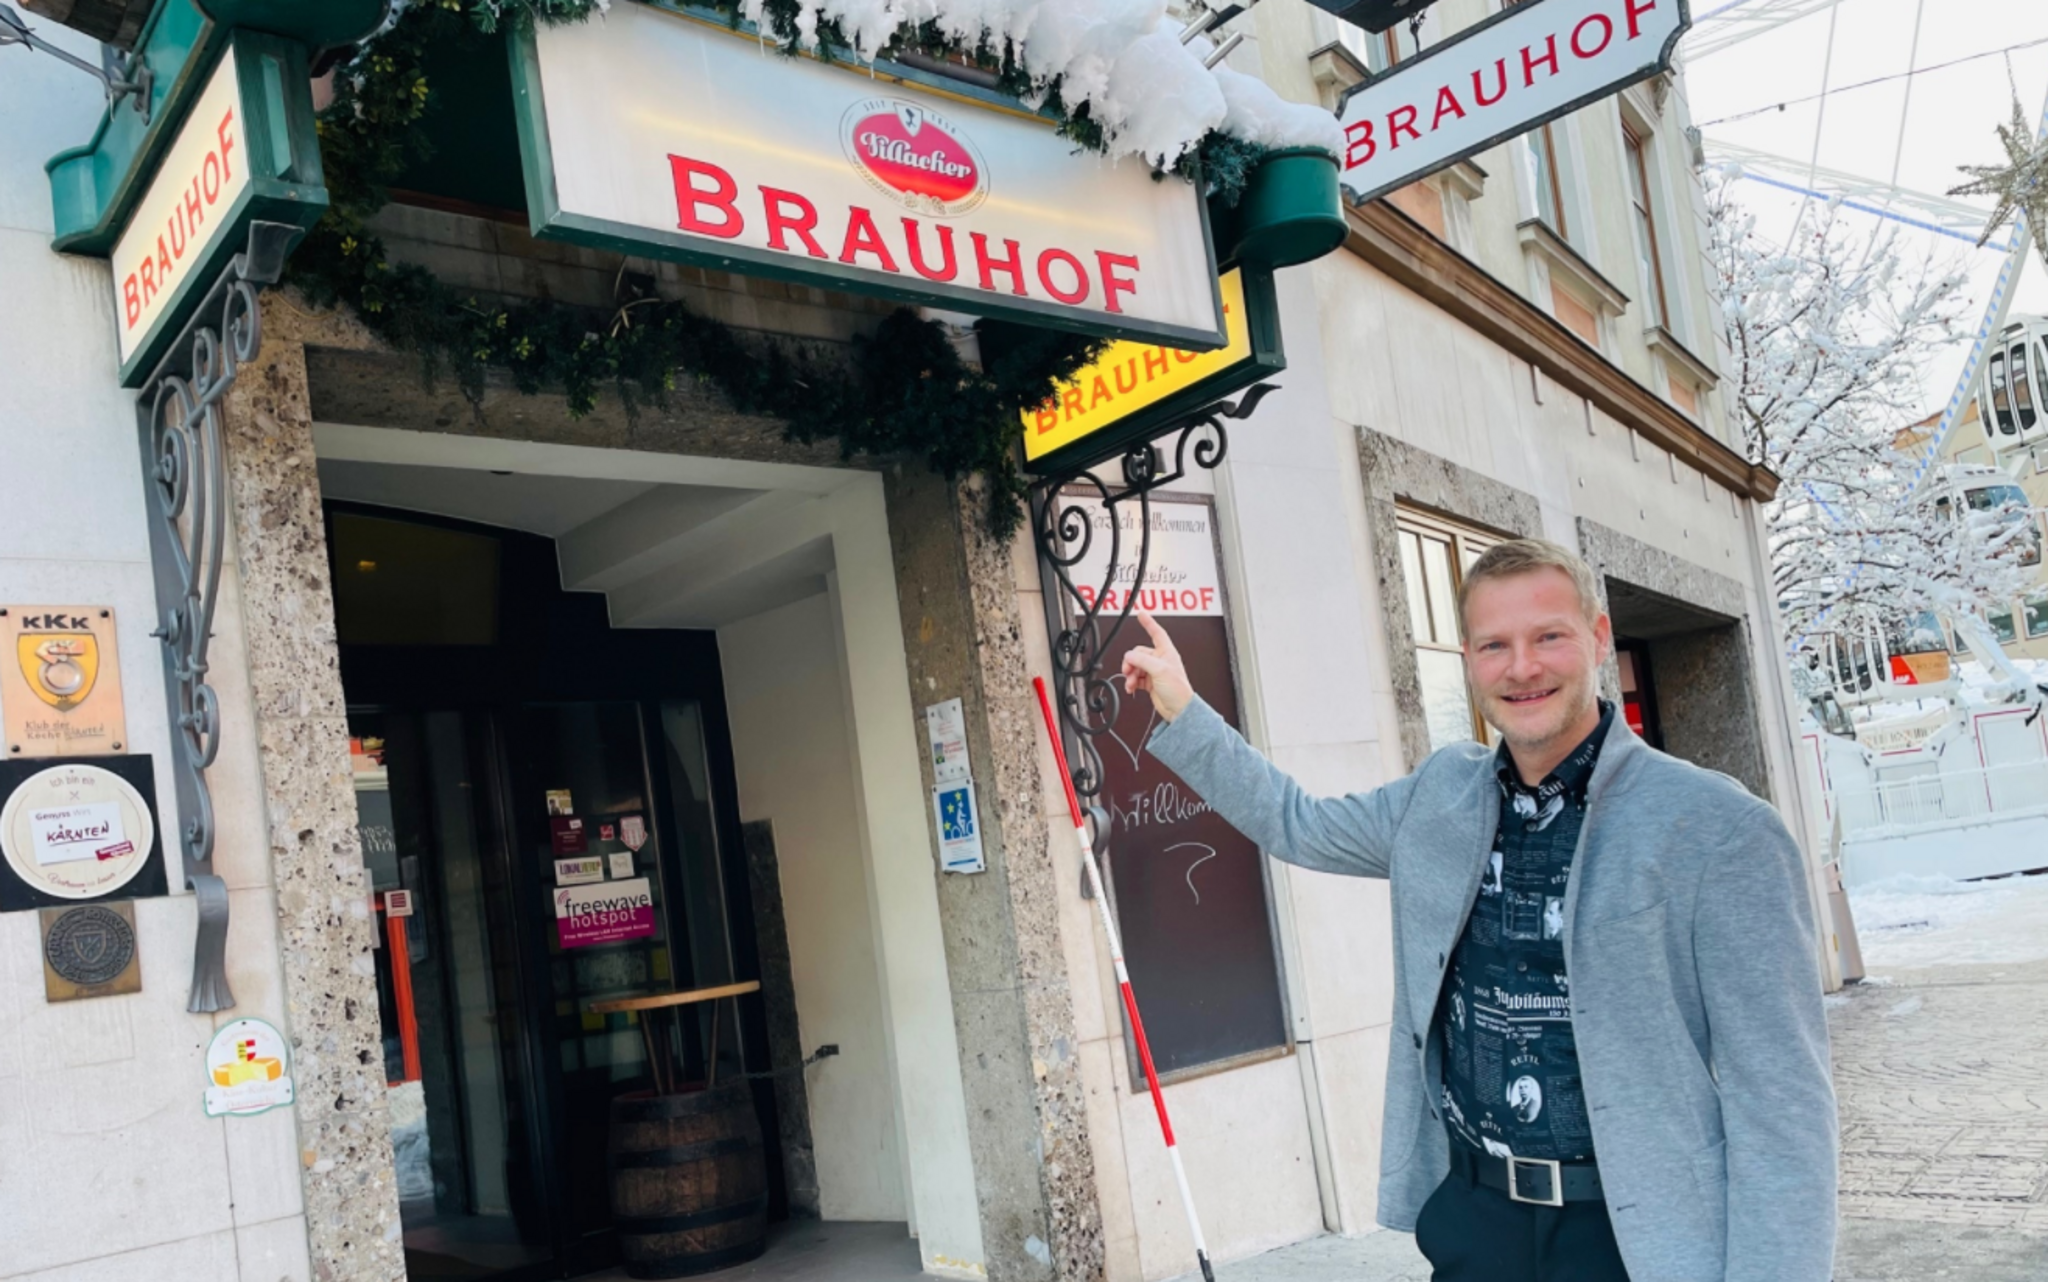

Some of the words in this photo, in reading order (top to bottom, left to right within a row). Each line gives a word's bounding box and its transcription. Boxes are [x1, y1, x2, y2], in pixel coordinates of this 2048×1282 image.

[1343, 0, 1656, 171] BRAUHOF
[859, 131, 972, 179] Villacher
[122, 104, 235, 332] BRAUHOF
[667, 152, 1140, 314] BRAUHOF
[564, 893, 649, 918] freewave
[570, 908, 637, 929] hotspot
[1510, 1054, 1540, 1067] RETTL
